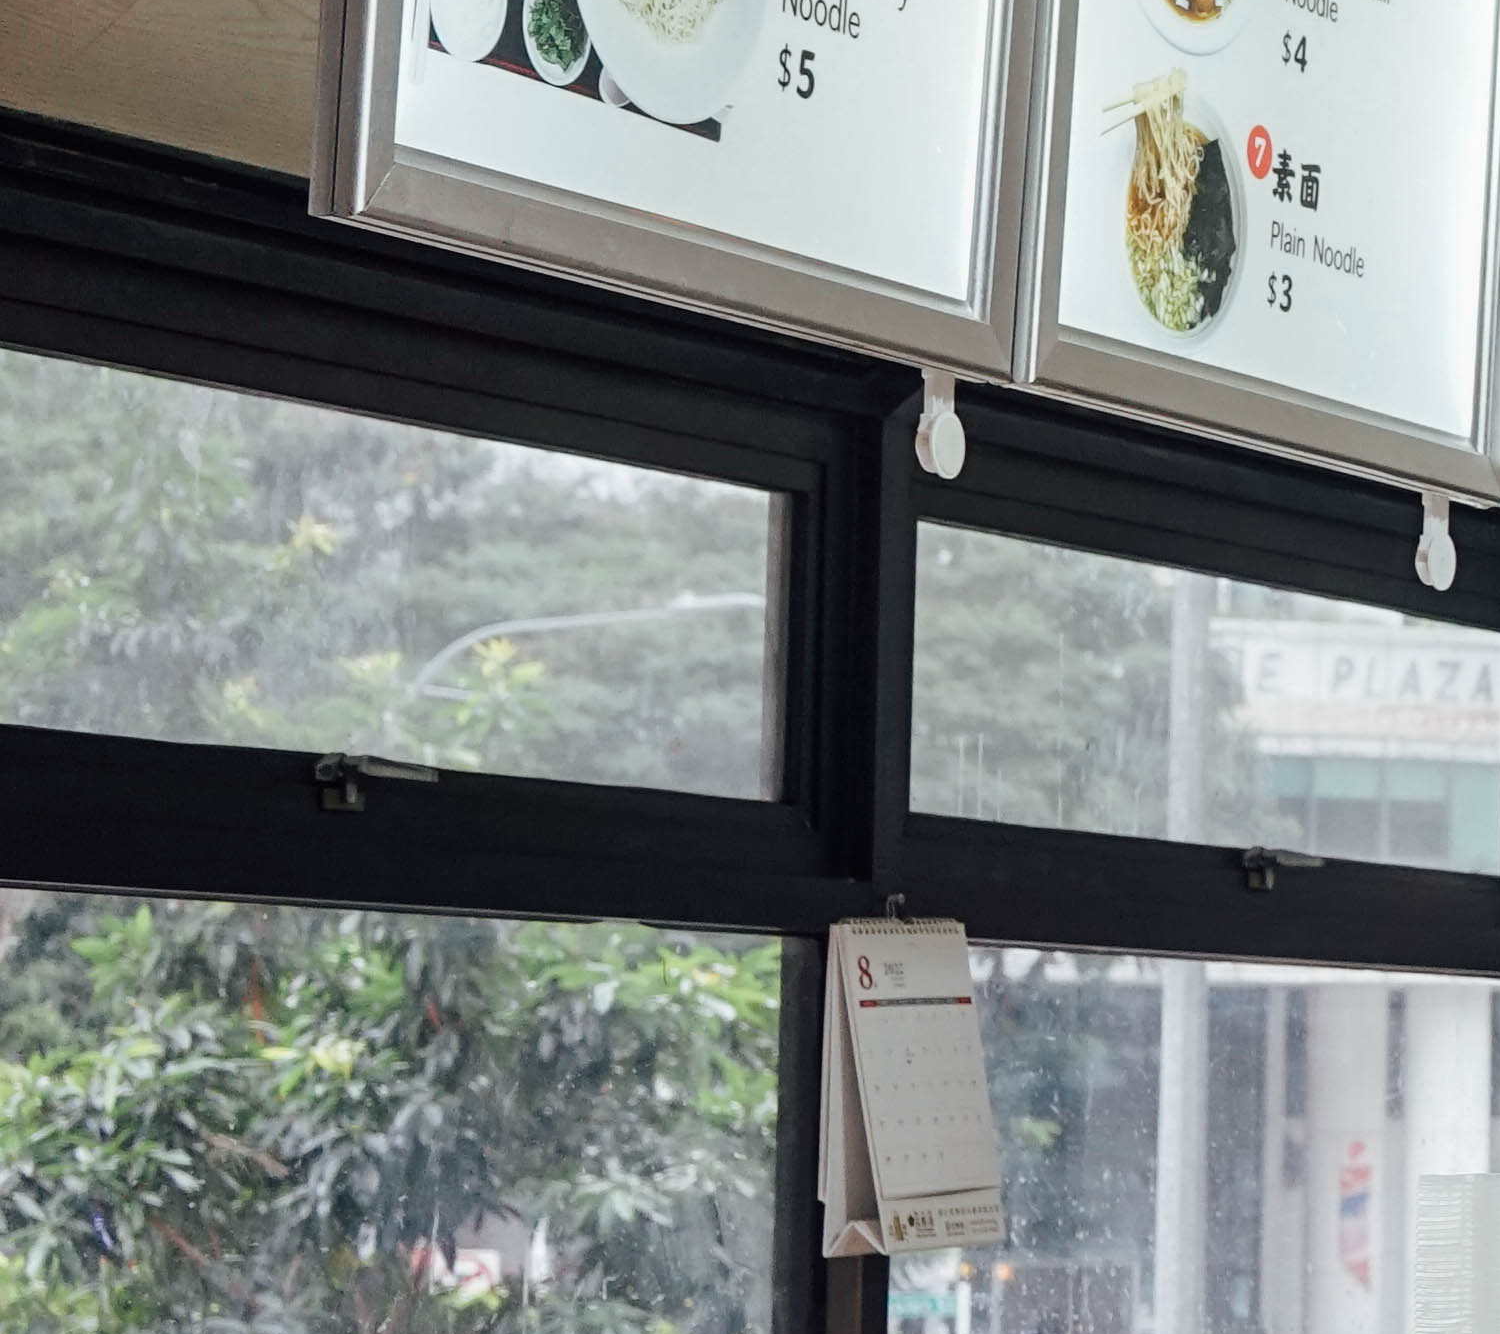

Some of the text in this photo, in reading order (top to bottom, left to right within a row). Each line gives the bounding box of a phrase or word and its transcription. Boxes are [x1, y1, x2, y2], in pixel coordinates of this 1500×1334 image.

[1253, 136, 1268, 172] 7
[1271, 148, 1322, 212] 素面
[1270, 219, 1365, 279] Plain Noodle
[1333, 655, 1496, 703] PLAZA
[857, 955, 873, 990] 8
